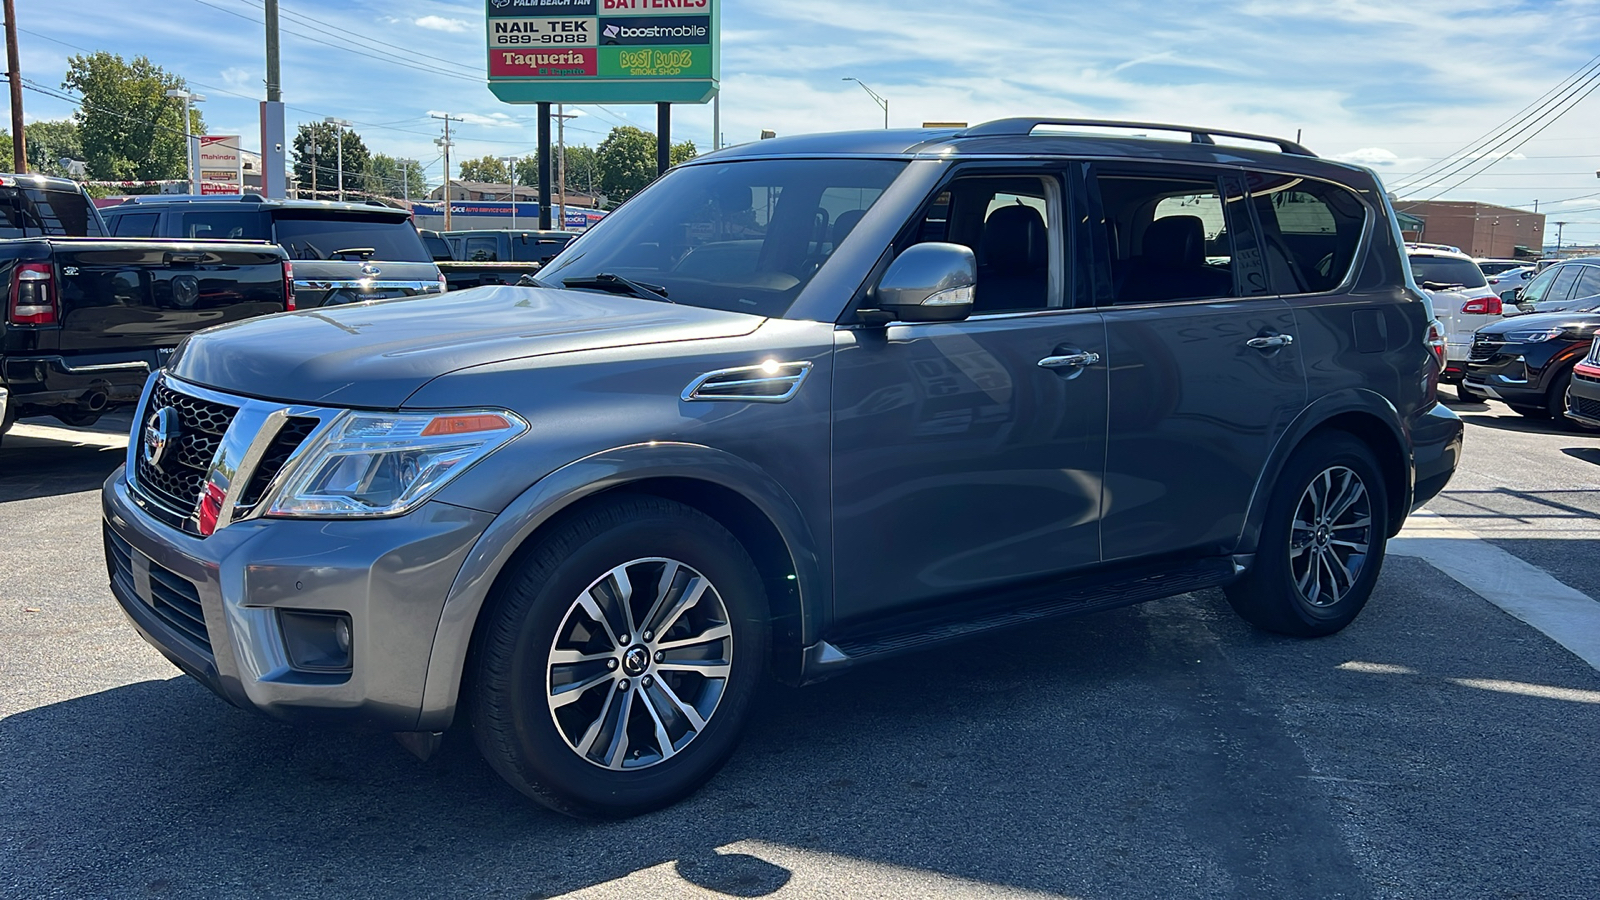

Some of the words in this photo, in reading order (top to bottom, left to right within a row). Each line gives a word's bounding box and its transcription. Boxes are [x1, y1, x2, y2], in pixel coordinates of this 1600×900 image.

[604, 0, 707, 9] BATTERIES
[495, 22, 539, 33] NAIL
[547, 21, 588, 32] TEK
[497, 34, 588, 44] 689-9088
